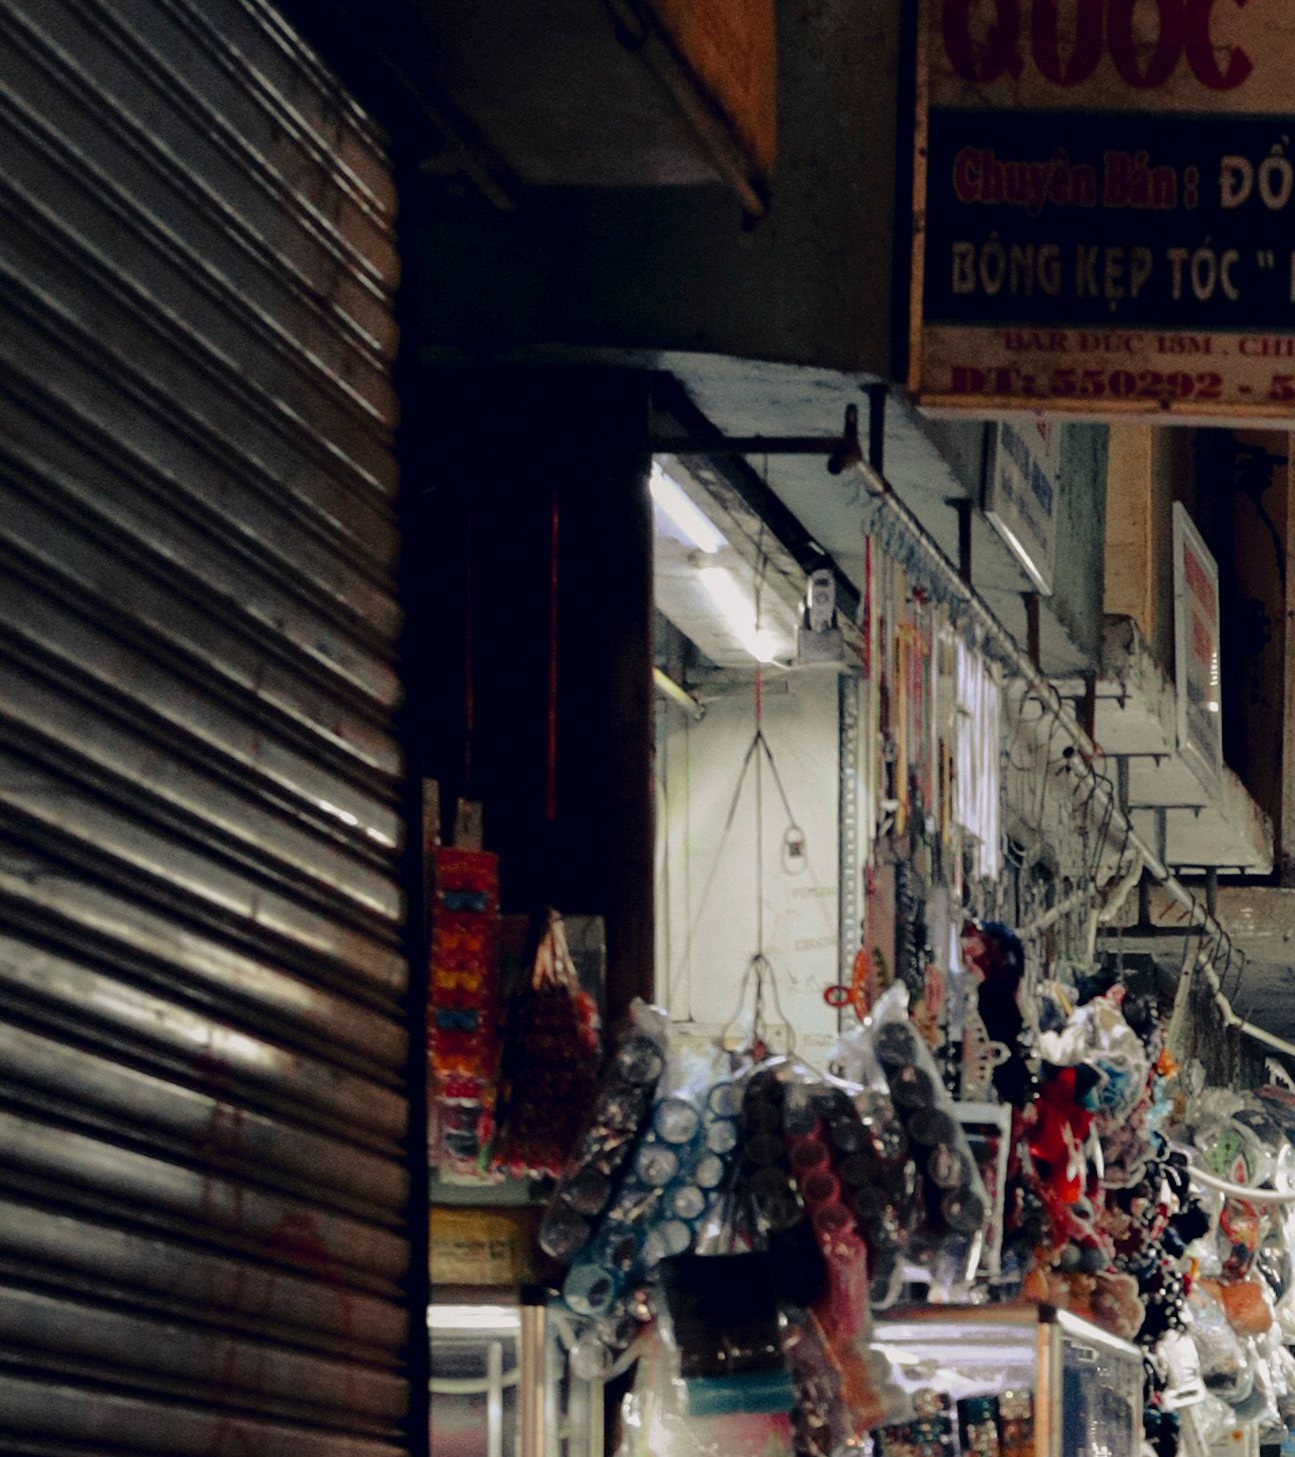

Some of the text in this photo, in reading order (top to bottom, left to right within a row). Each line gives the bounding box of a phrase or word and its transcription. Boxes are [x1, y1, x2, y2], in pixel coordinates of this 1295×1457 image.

[952, 145, 1097, 218] Chuyên
[1219, 133, 1294, 211] ĐỒ
[1075, 244, 1153, 312] KẸP
[1165, 235, 1241, 300] TÓC
[1238, 337, 1294, 357] CHI
[1050, 368, 1223, 400] 550292
